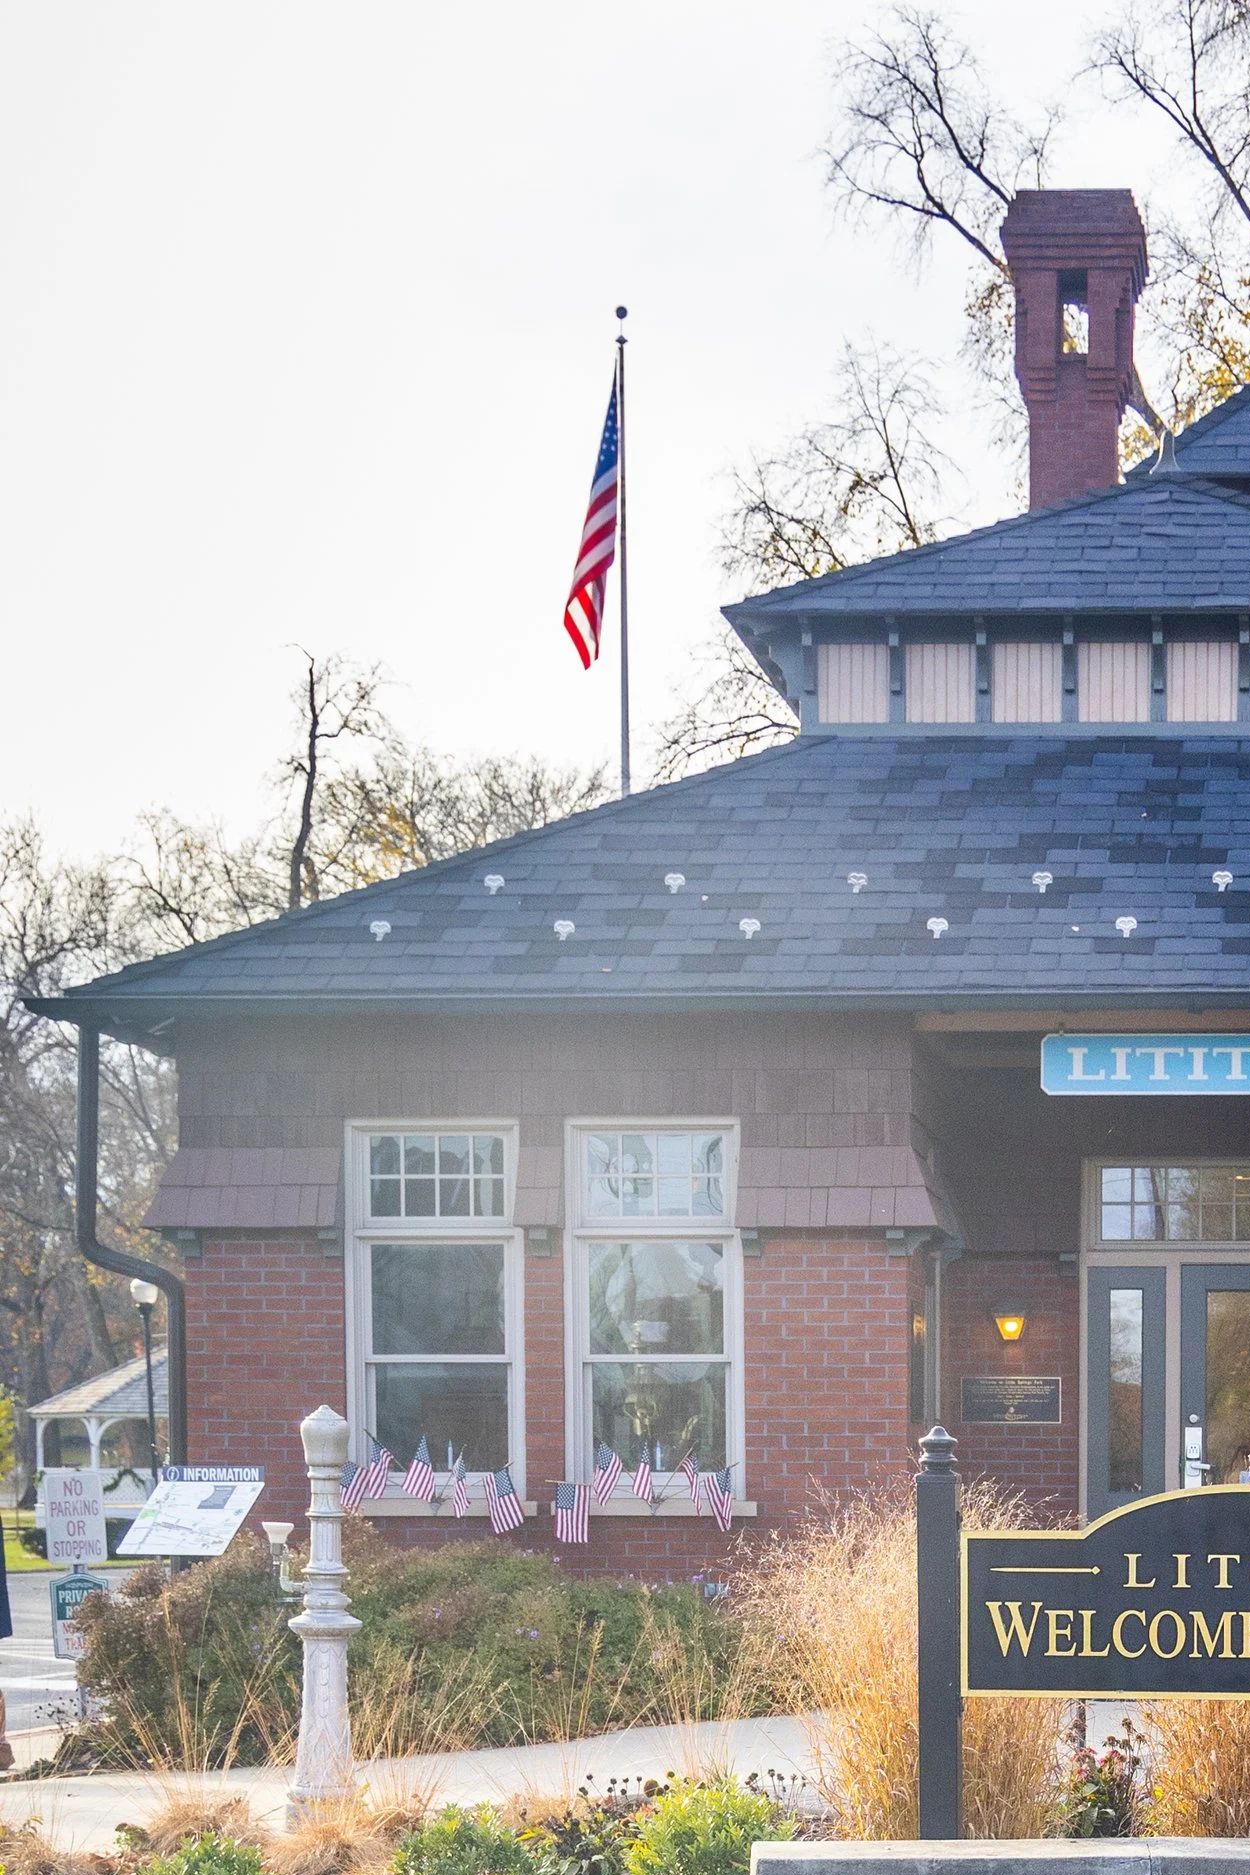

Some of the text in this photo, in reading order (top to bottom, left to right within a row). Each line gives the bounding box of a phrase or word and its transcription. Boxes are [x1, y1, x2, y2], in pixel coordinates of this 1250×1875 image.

[183, 1467, 260, 1481] INFORMATION
[63, 1480, 83, 1496] NO
[50, 1500, 100, 1517] PARKING
[66, 1520, 86, 1537] OR
[53, 1540, 102, 1557] STOPPING
[58, 1589, 96, 1604] PRIVA
